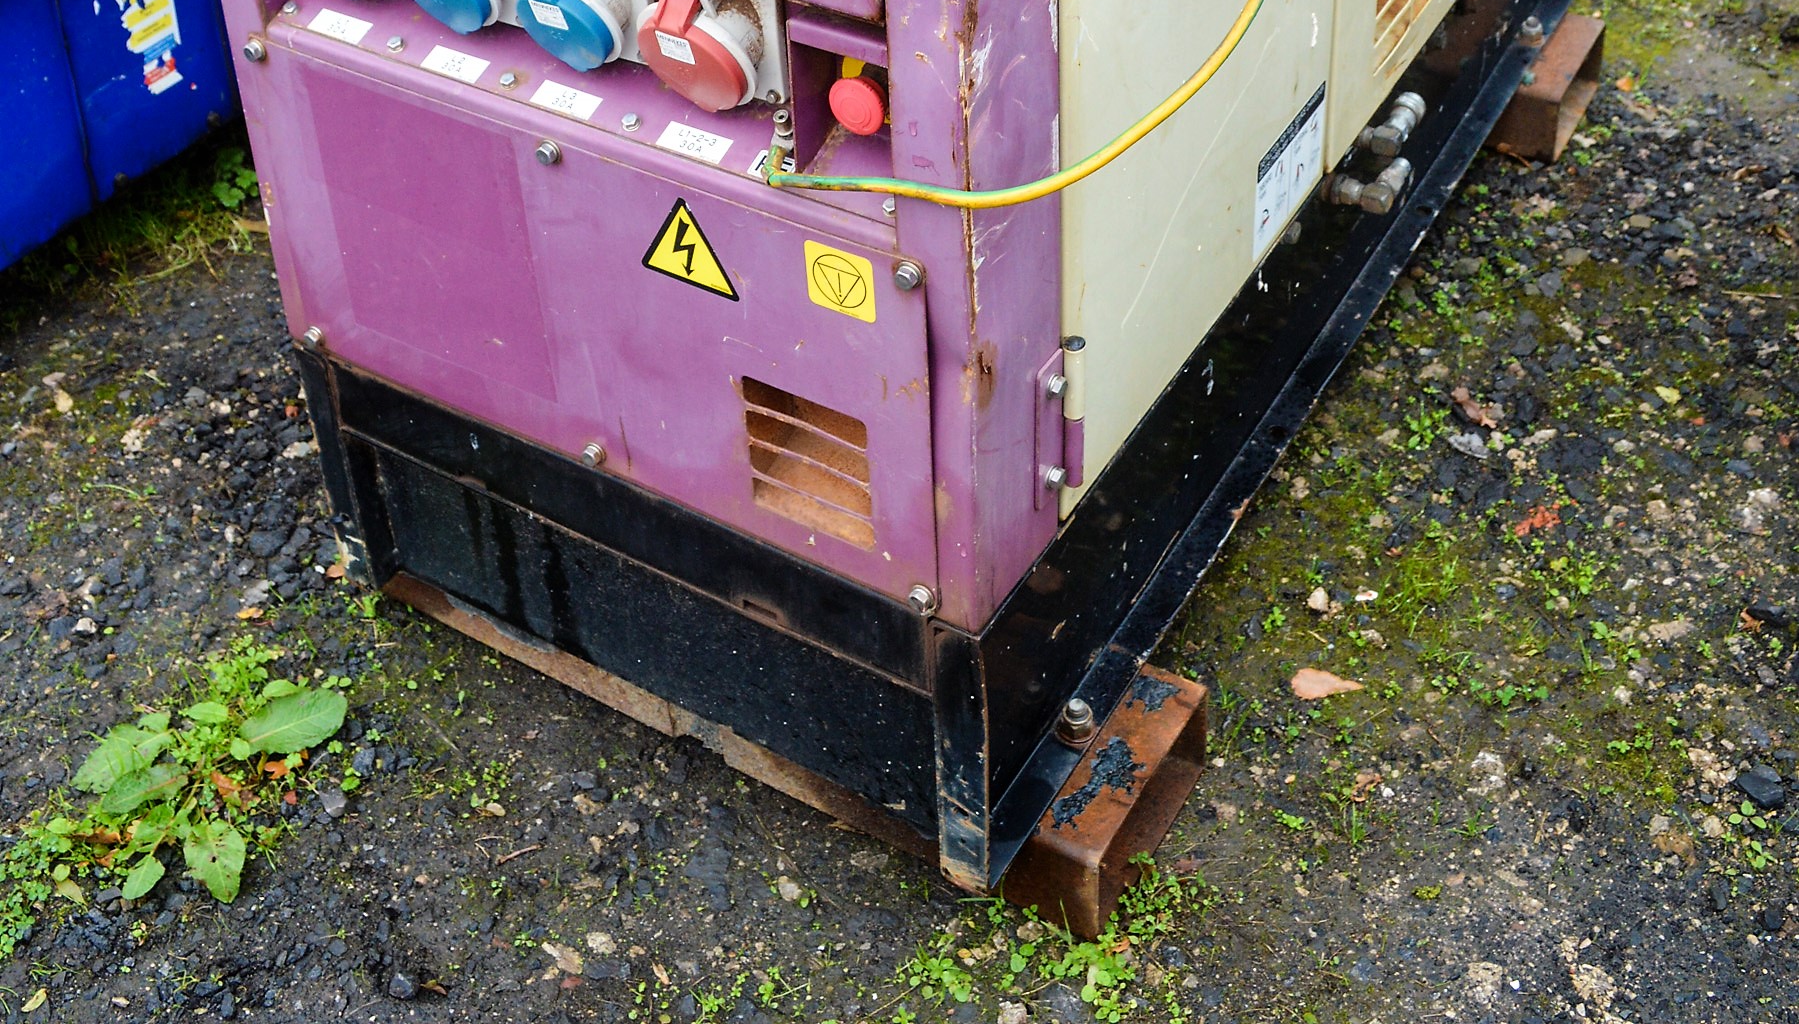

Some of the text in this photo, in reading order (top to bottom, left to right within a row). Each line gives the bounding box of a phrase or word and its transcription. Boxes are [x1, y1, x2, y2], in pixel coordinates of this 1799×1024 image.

[551, 97, 574, 110] 30A
[677, 128, 718, 147] L1-2-3
[678, 139, 703, 154] 30A
